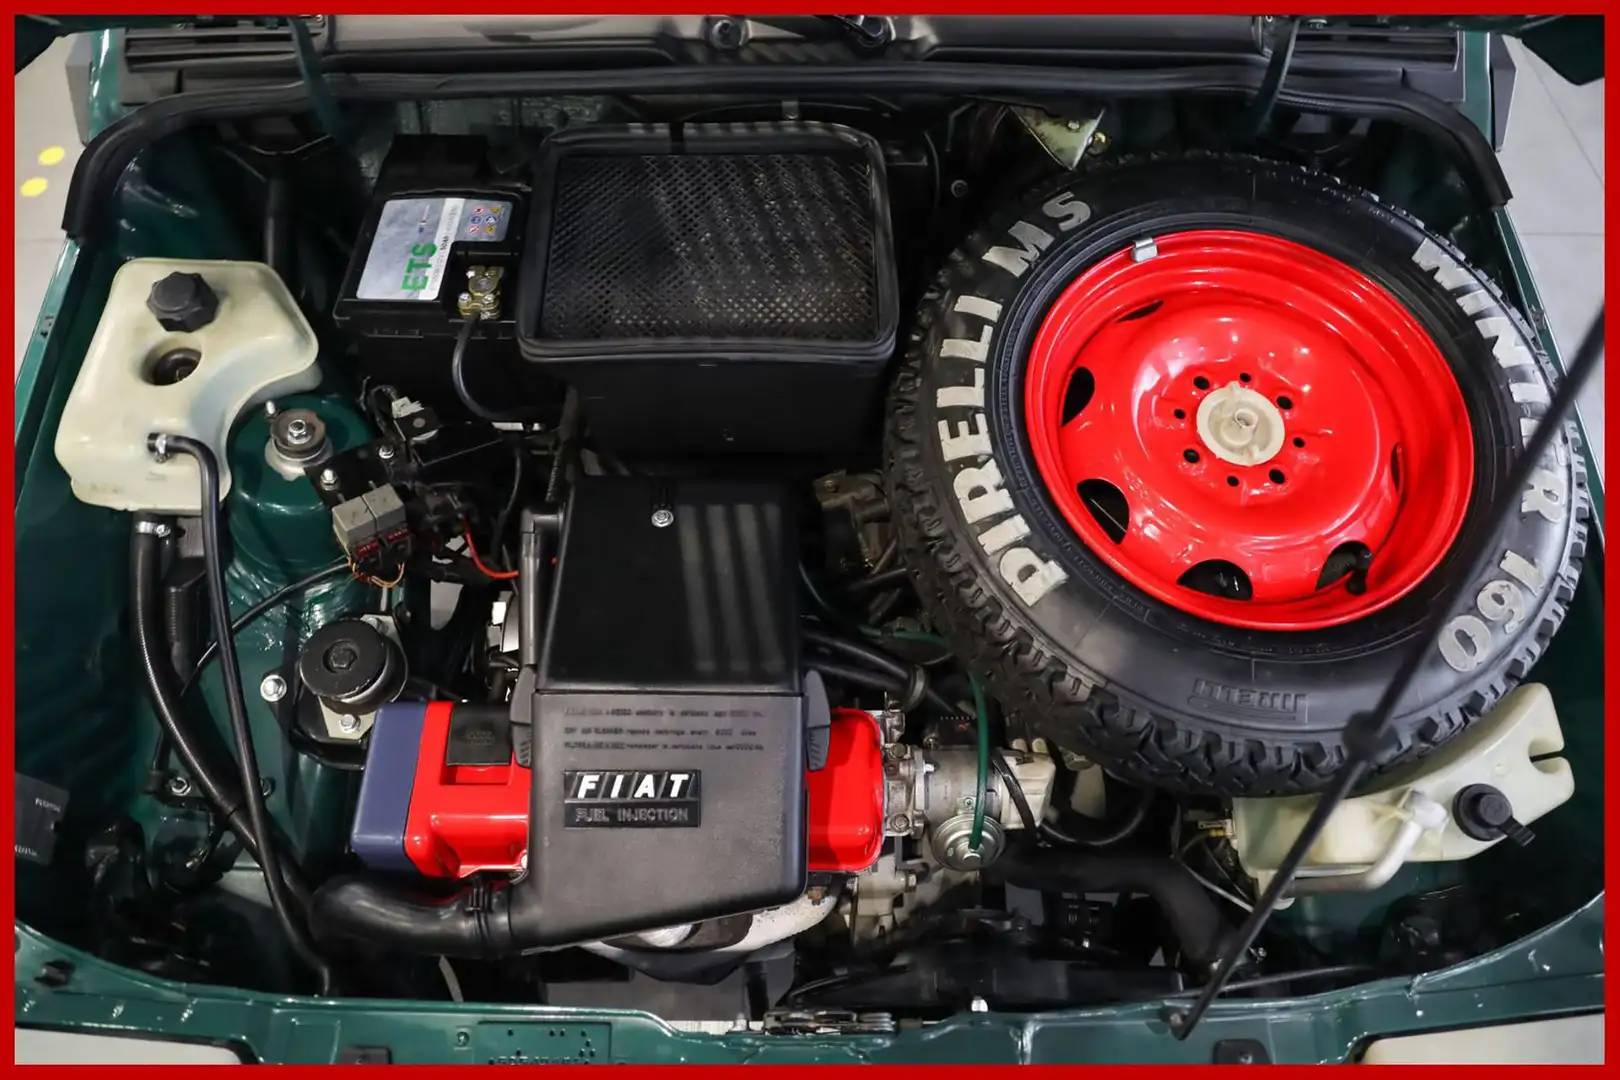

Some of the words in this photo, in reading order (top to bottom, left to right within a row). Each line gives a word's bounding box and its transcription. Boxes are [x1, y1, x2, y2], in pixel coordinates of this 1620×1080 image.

[401, 242, 437, 291] ETS
[982, 192, 1092, 279] MS
[937, 295, 1069, 606] PIRELLI
[1437, 550, 1545, 672] 160
[575, 807, 610, 822] FUEL
[616, 807, 689, 822] INJECTION
[577, 773, 690, 800] FIAT
